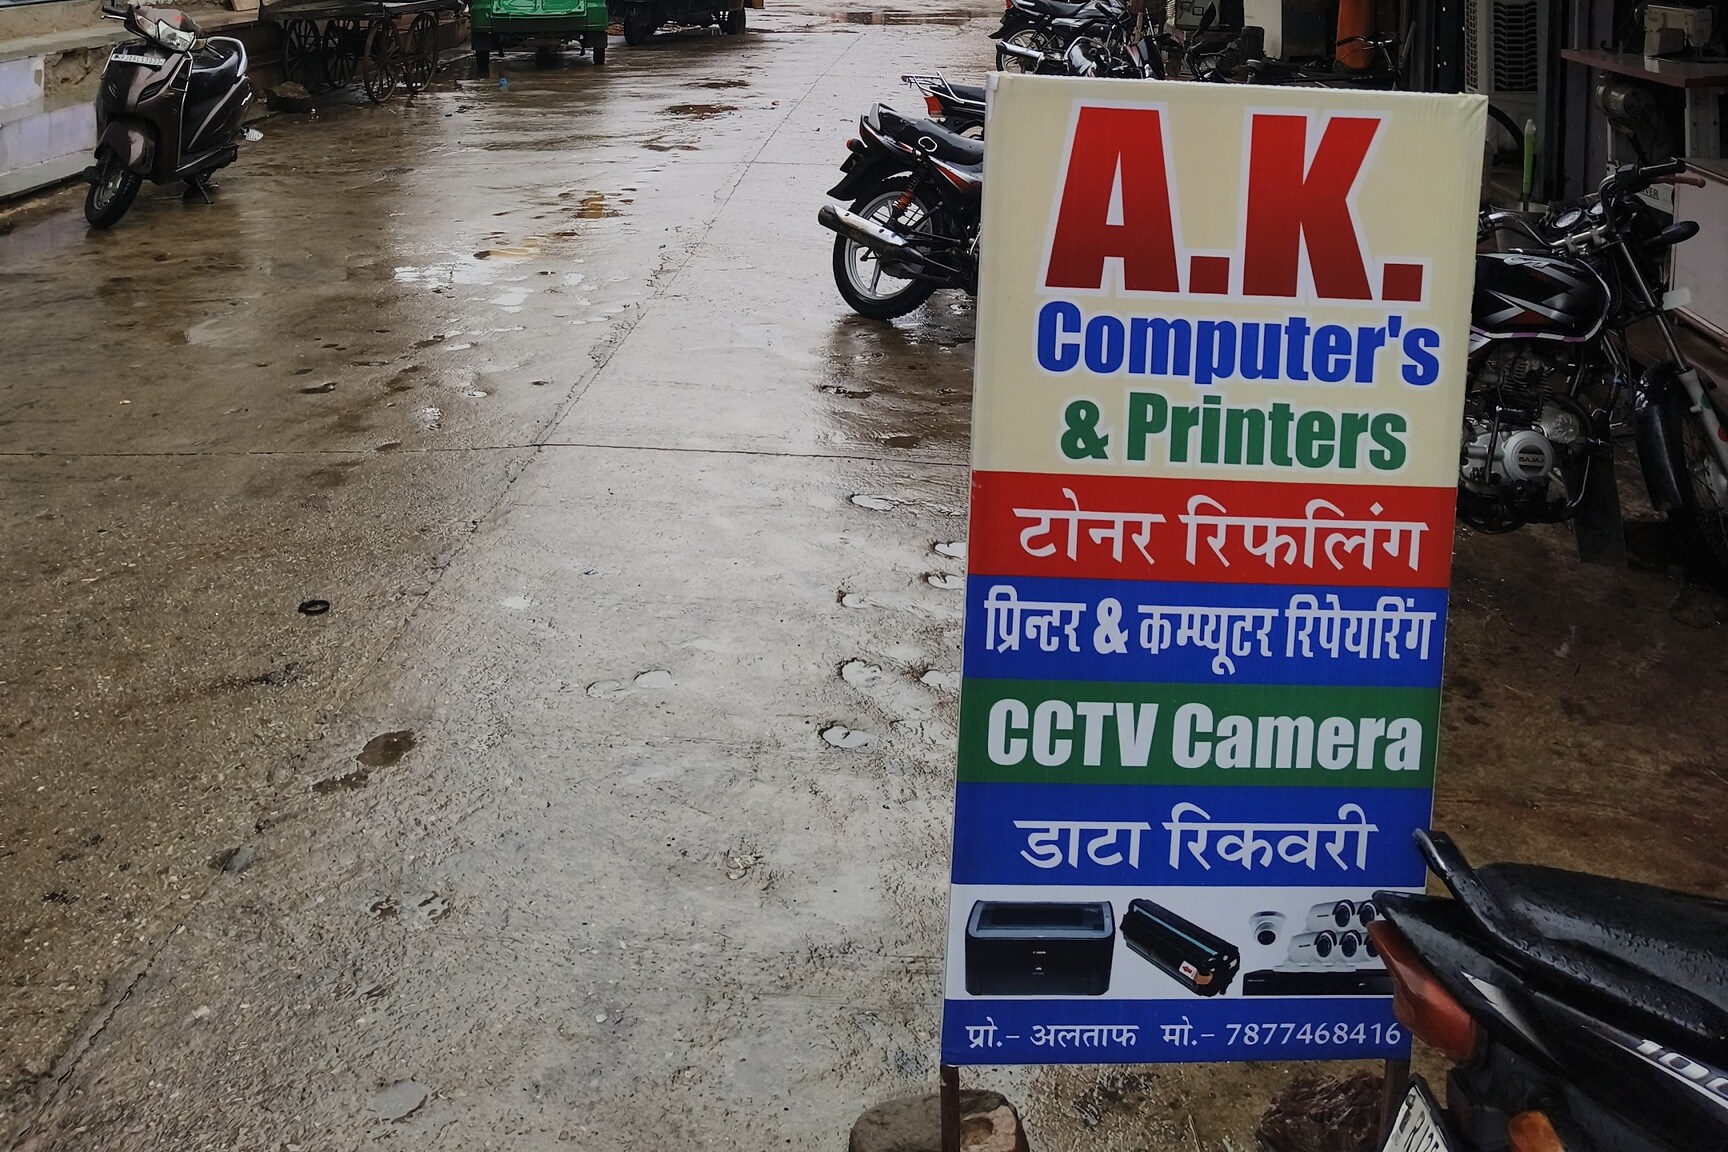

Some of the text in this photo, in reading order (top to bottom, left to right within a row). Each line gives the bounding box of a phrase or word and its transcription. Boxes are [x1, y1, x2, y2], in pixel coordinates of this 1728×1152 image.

[1045, 105, 1424, 302] A.K.
[1037, 300, 1440, 387] Computer's
[1061, 392, 1408, 470] & Printers
[1013, 488, 1430, 572] टोनर रिफलिंग
[984, 585, 1437, 675] प्रिन्टर & कम्प्यूटर रिपेयरिंग
[988, 698, 1422, 771] CCTV Camera
[1014, 803, 1379, 871] डाटा रिकवरी
[1029, 1024, 1140, 1048] अलताफ
[1225, 1022, 1402, 1047] 7877468416
